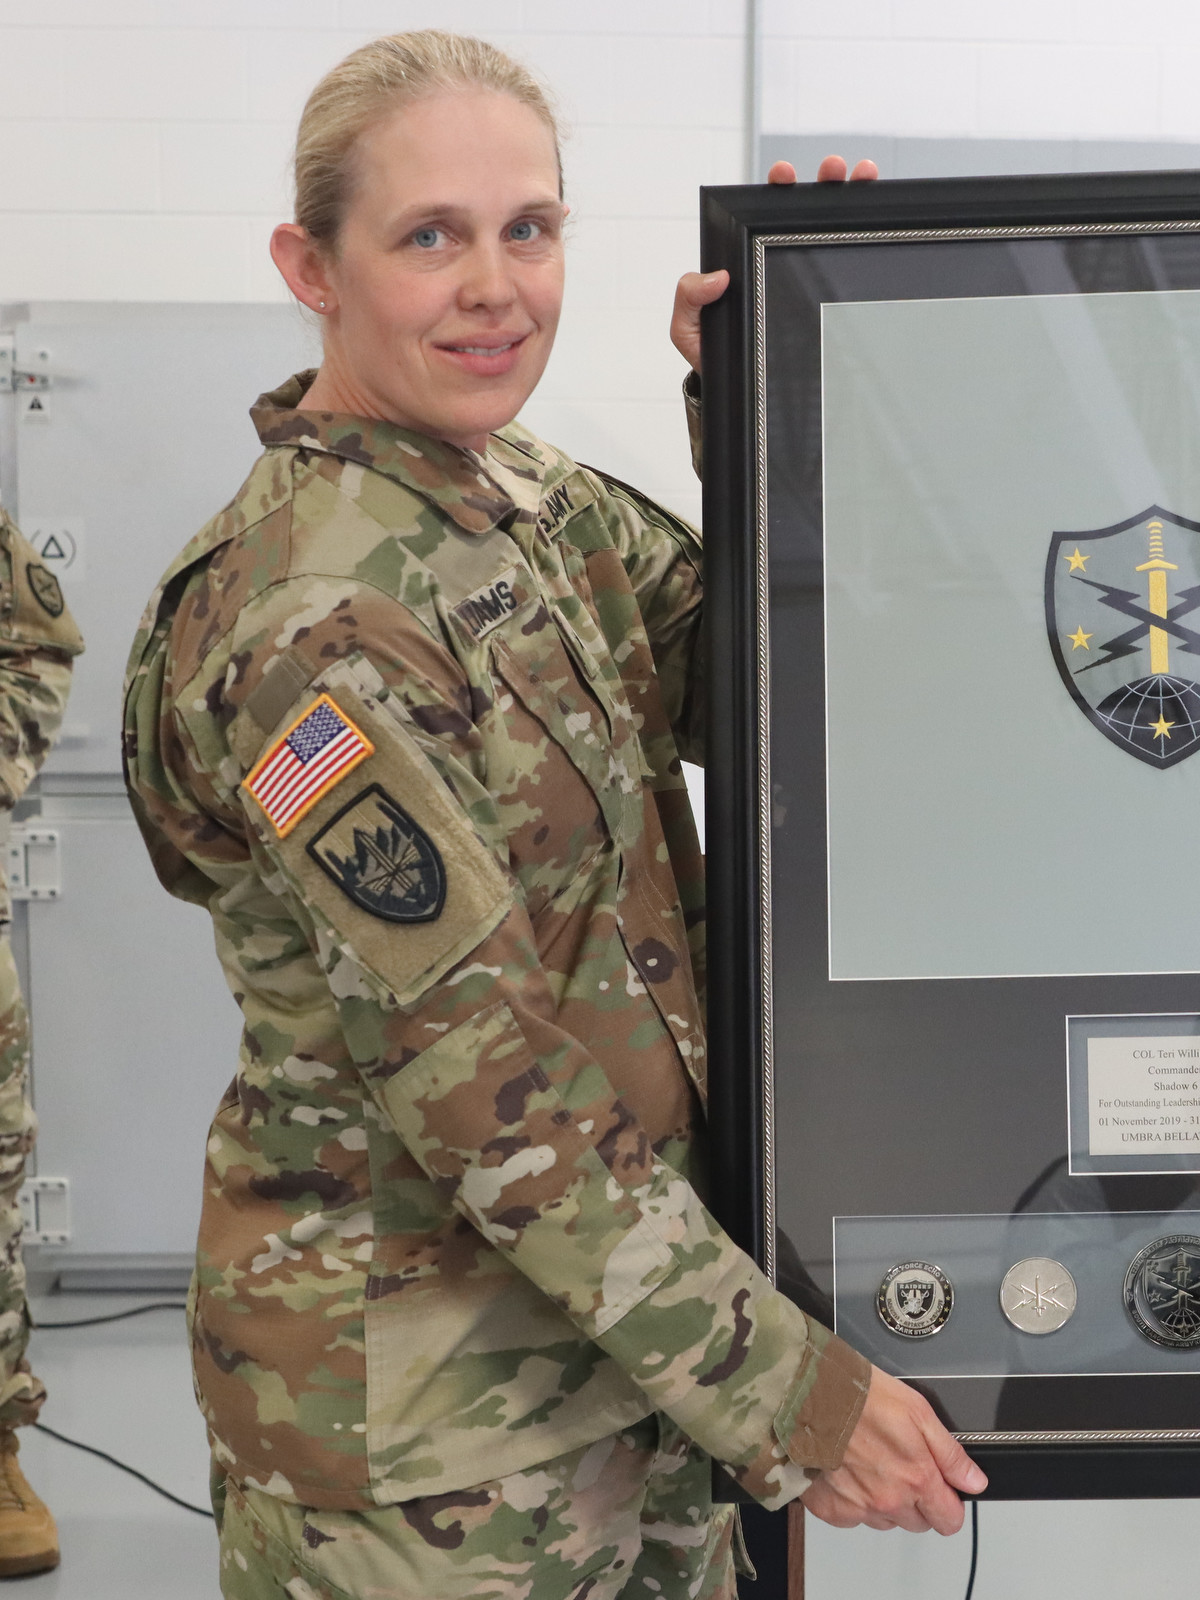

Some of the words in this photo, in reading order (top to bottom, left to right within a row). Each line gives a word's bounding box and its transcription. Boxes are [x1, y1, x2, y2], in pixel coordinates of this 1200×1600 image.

[1132, 1049, 1155, 1059] COL
[1158, 1049, 1175, 1059] Teri
[1153, 1081, 1190, 1091] Shadow
[1192, 1081, 1198, 1090] 6
[1098, 1099, 1112, 1108] For
[1113, 1098, 1161, 1109] Outstanding
[1098, 1117, 1109, 1127] 01
[1112, 1116, 1157, 1127] November
[1159, 1115, 1181, 1126] 2019
[1189, 1115, 1200, 1125] 31
[1121, 1132, 1162, 1142] UMBRA
[899, 1262, 923, 1271] FORCE
[923, 1264, 941, 1277] ECHO
